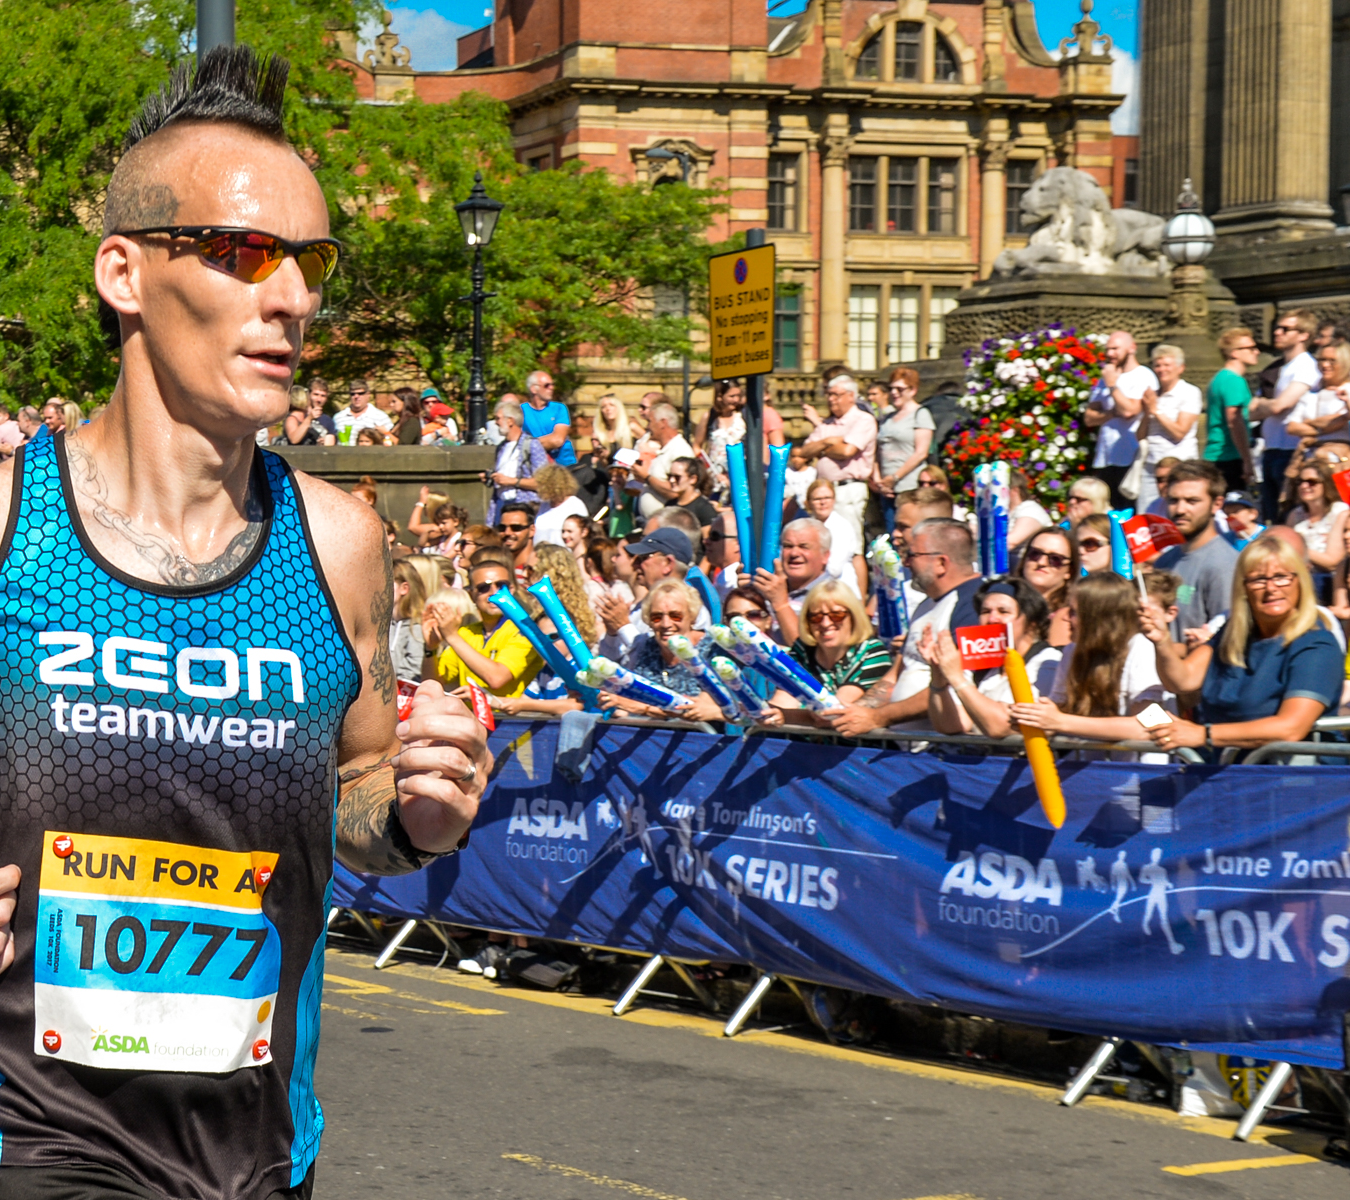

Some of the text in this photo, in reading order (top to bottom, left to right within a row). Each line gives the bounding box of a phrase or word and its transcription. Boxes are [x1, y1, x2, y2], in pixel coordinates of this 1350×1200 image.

[714, 287, 770, 310] BUS STAND
[715, 309, 768, 328] No stopping
[715, 349, 769, 367] except buses
[960, 632, 1007, 655] heart
[38, 630, 304, 704] ZEON
[50, 693, 296, 750] teamwear
[507, 797, 818, 842] ASDA Jane Tomlinson's
[62, 850, 137, 881] RUN
[152, 857, 219, 890] FOR
[505, 836, 839, 912] foundation 10K SERIES
[939, 850, 1063, 906] ASDA
[1202, 848, 1272, 878] Jane
[53, 929, 61, 973] FOUNDATION
[75, 913, 269, 981] 10777
[937, 895, 1060, 935] foundation
[1195, 908, 1297, 964] 10K
[93, 1034, 230, 1058] ASDA foundation
